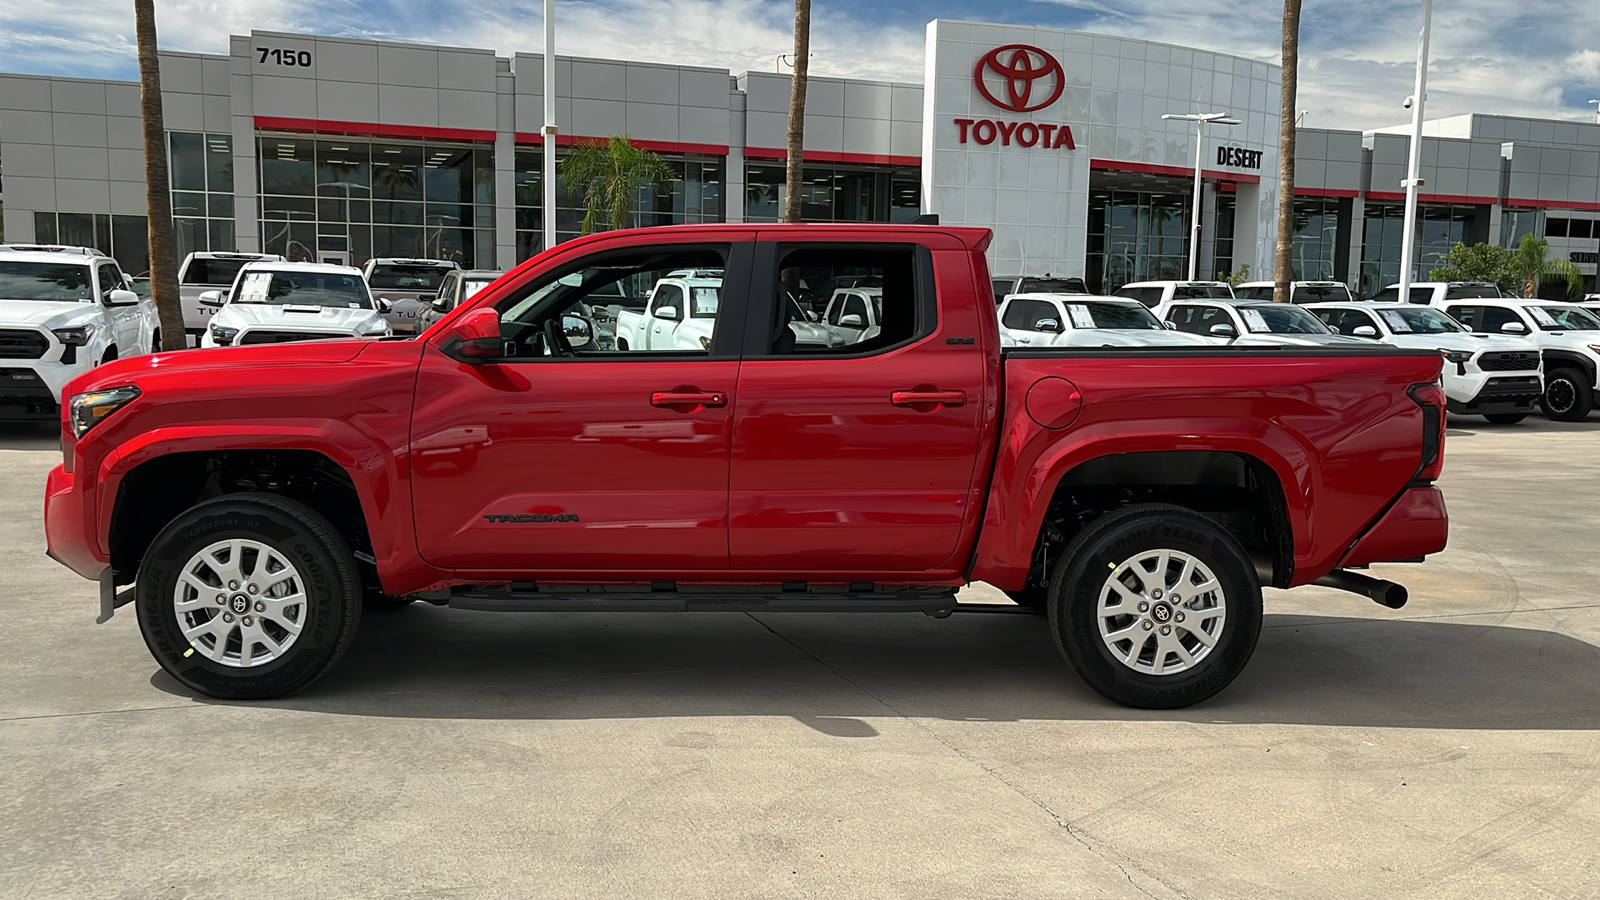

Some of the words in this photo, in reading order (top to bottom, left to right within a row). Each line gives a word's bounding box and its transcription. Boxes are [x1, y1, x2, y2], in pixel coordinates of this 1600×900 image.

[256, 47, 312, 67] 7150
[953, 118, 1076, 150] TOYOTA
[1217, 146, 1263, 169] DESERT
[483, 514, 580, 523] TACOMA
[1106, 523, 1205, 557] GOODYEAR
[294, 542, 333, 643] GOODYEAR
